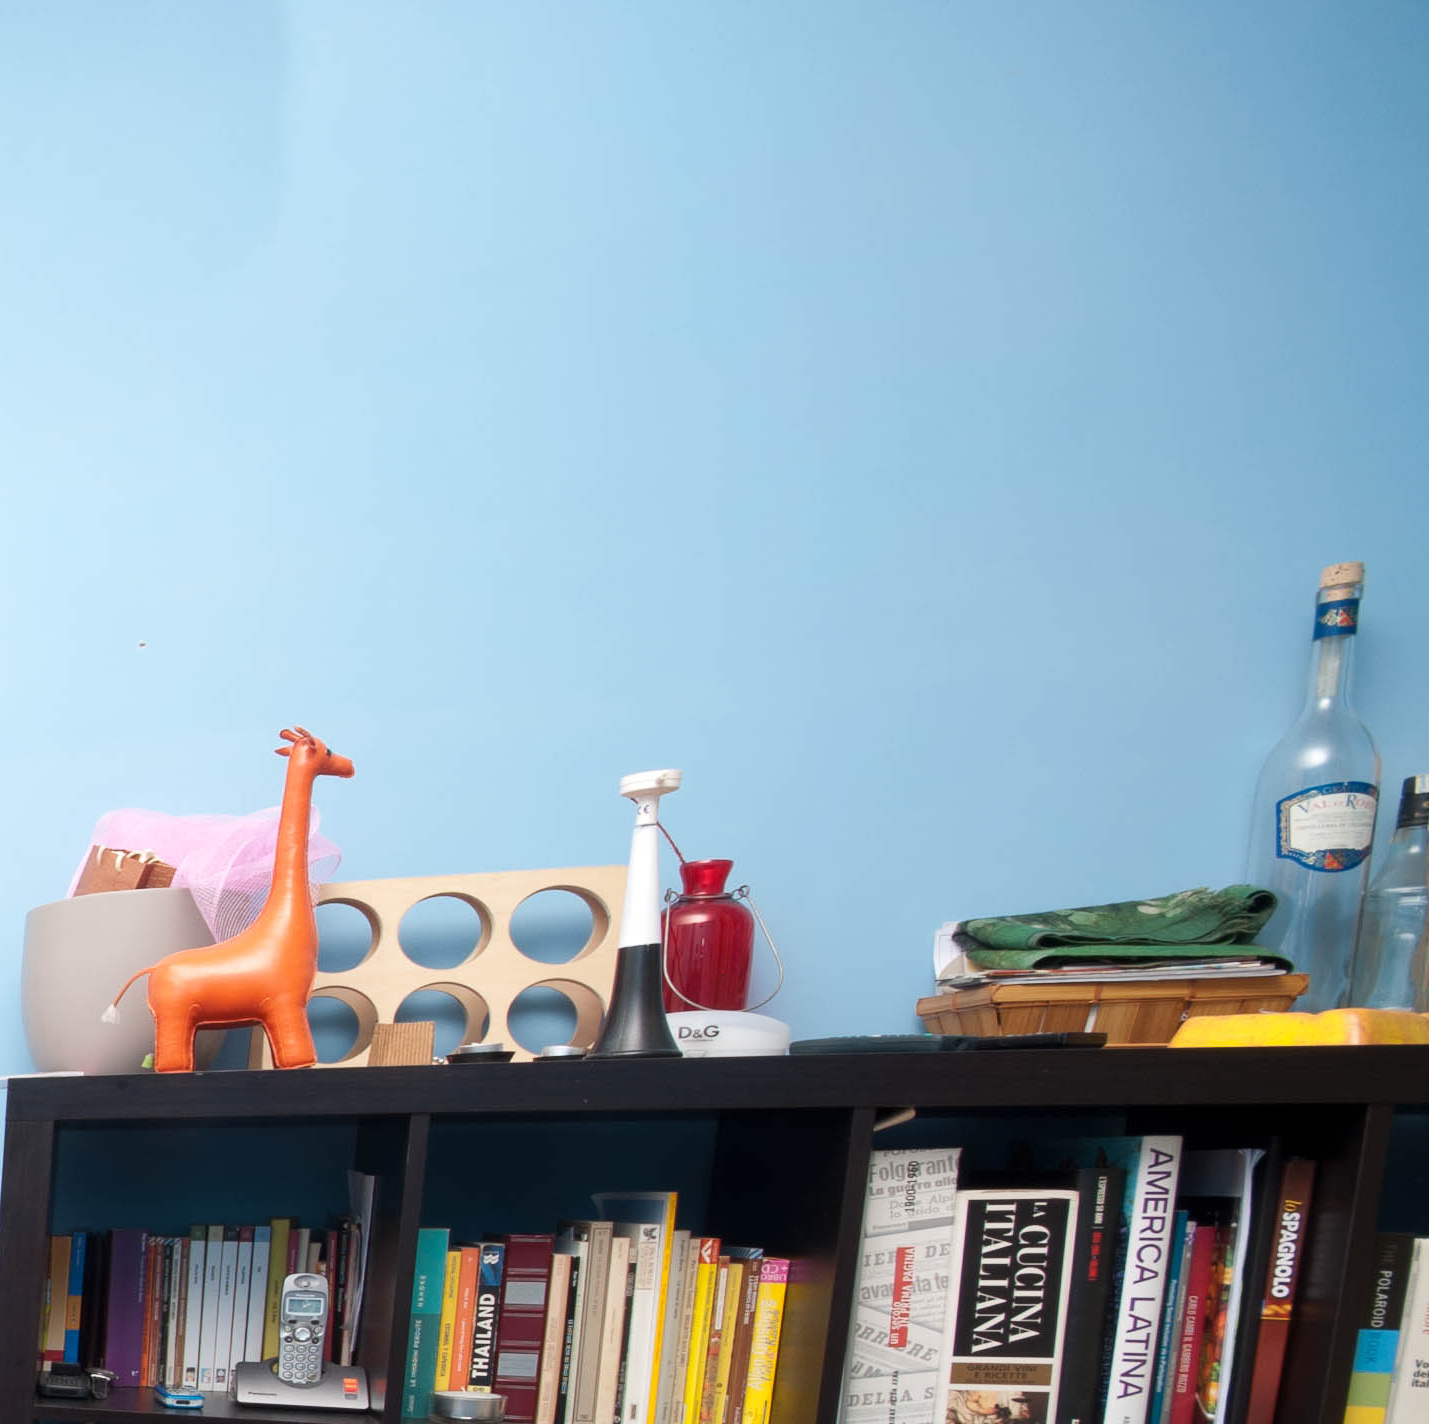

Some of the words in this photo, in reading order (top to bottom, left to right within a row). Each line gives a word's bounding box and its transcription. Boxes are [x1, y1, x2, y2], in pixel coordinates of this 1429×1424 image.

[678, 1025, 720, 1039] D&G
[904, 1160, 920, 1213] 1900-1960
[1285, 1199, 1303, 1211] lo
[1032, 1201, 1047, 1218] LA
[1132, 1148, 1174, 1285] AMERICA
[761, 1263, 779, 1273] CD
[901, 1247, 916, 1281] PAGINA
[1271, 1212, 1301, 1298] SPAGNOLO
[898, 1284, 913, 1315] PRIMA
[971, 1202, 1017, 1354] ITALIANA
[1007, 1225, 1051, 1344] CUCINA
[1369, 1270, 1392, 1328] POLAROID
[472, 1293, 496, 1378] THAILAND
[890, 1301, 902, 1330] secolo
[890, 1332, 899, 1345] un
[1116, 1296, 1156, 1400] LATINA
